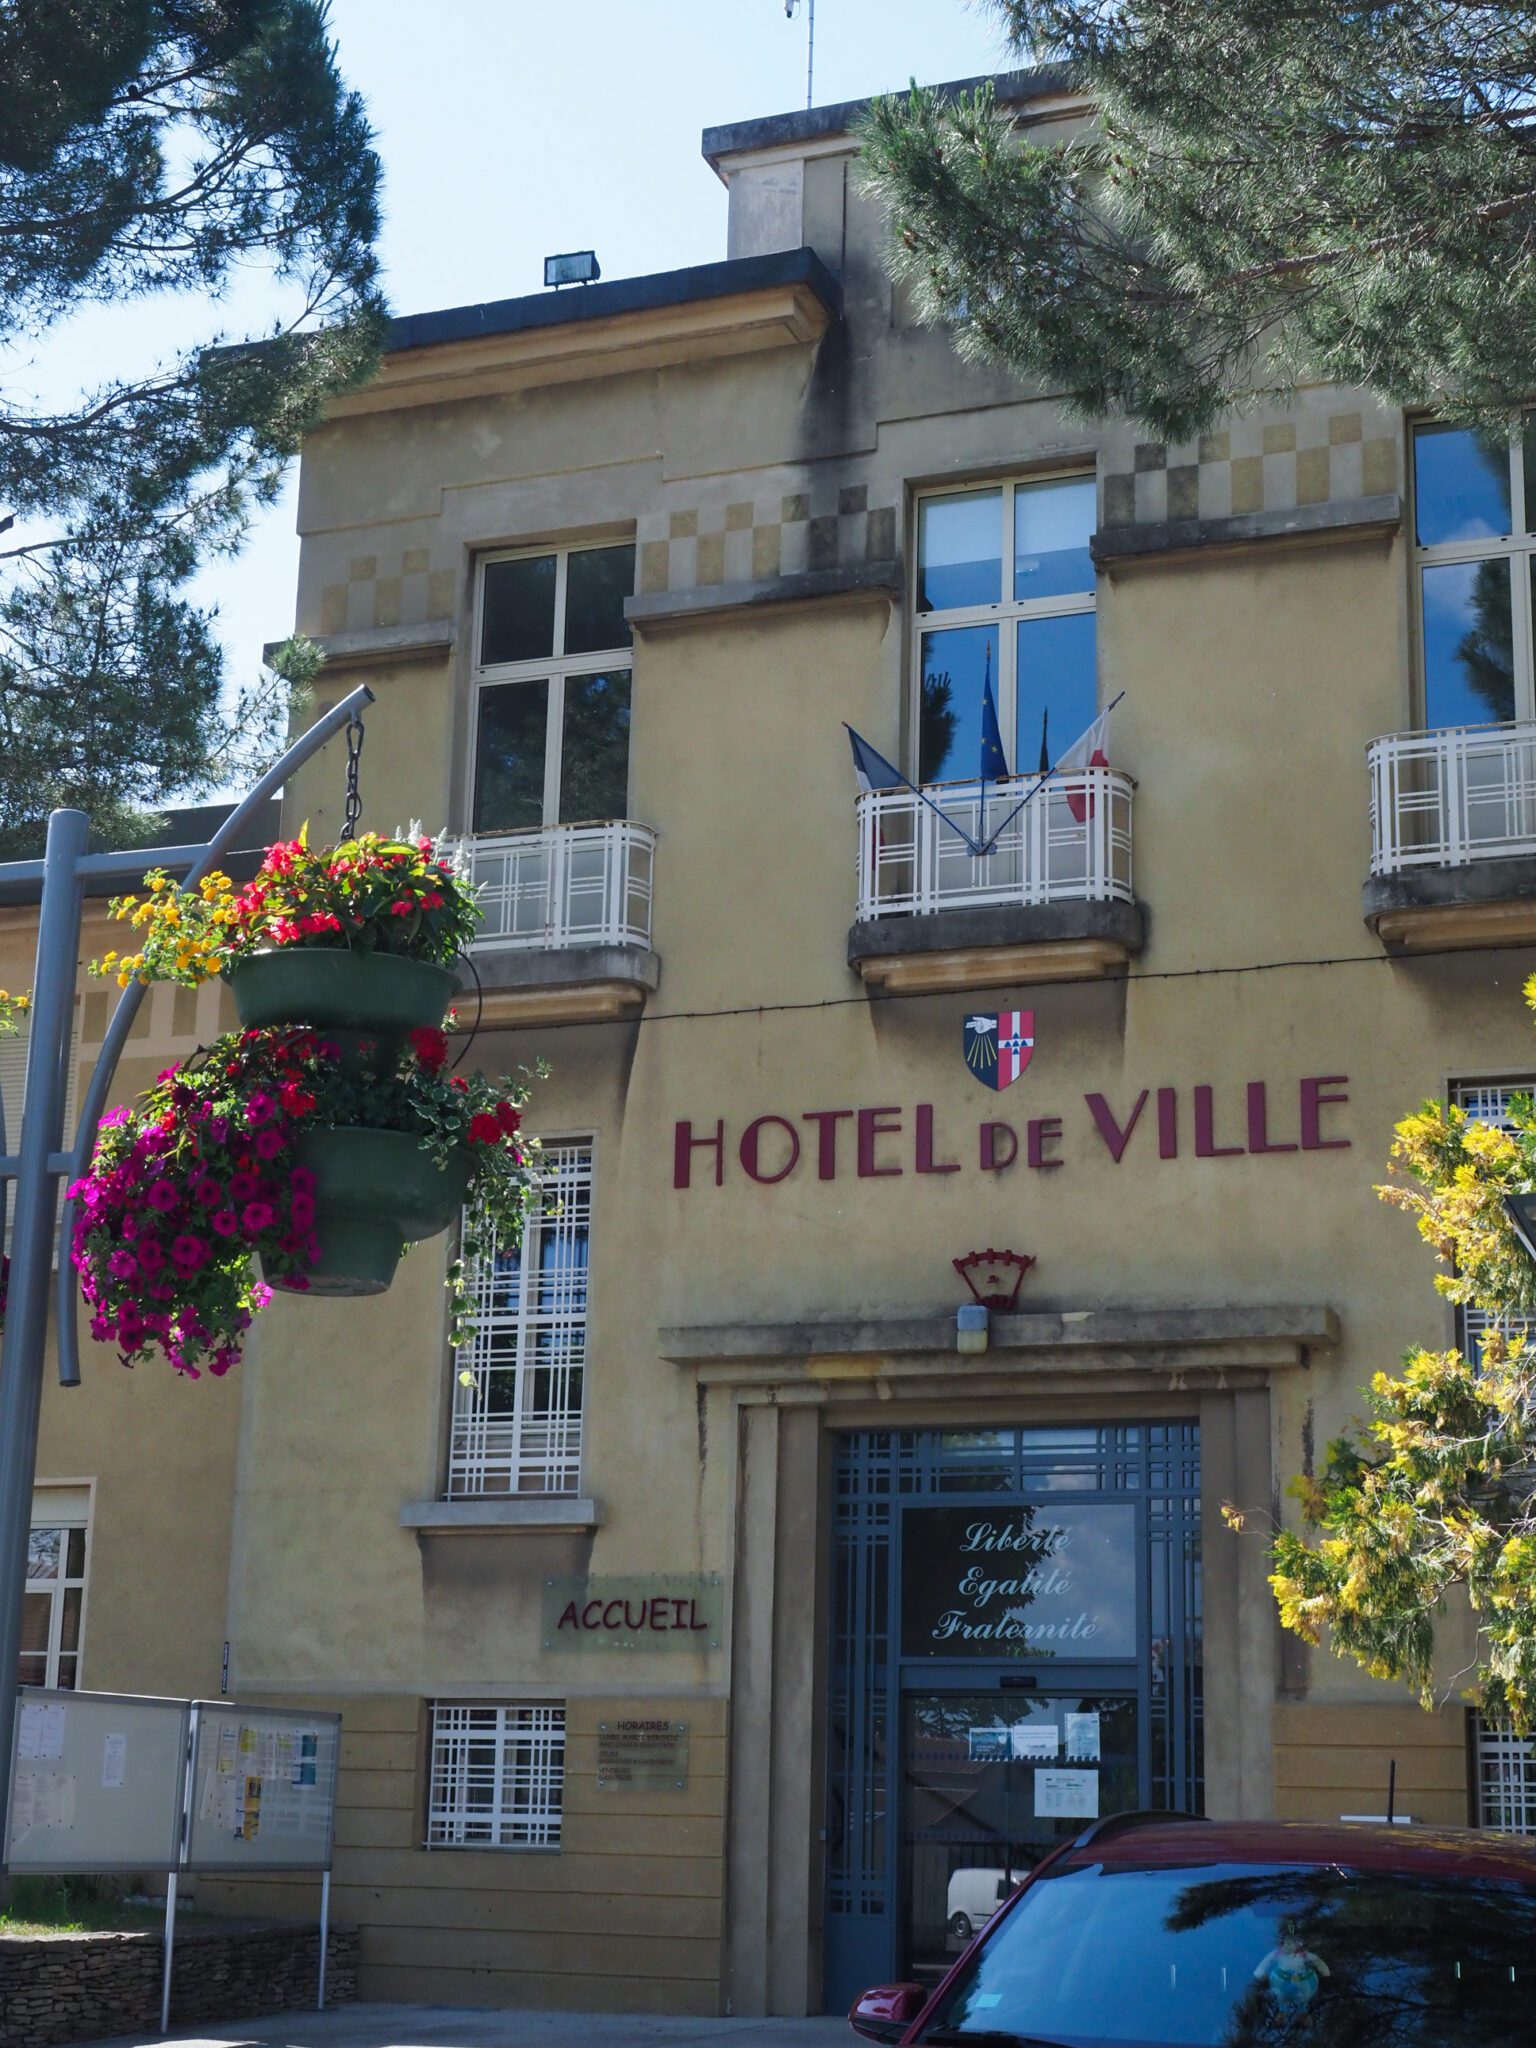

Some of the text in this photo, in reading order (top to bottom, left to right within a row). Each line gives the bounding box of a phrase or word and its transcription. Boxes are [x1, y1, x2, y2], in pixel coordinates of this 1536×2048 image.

[674, 1076, 1351, 1188] HOTEL DE VILLE
[960, 1522, 1071, 1552] Liberté
[958, 1566, 1072, 1608] Egalité
[557, 1598, 708, 1631] ACCUEIL
[931, 1610, 1100, 1640] Fraternité
[617, 1721, 669, 1731] HORAIRES
